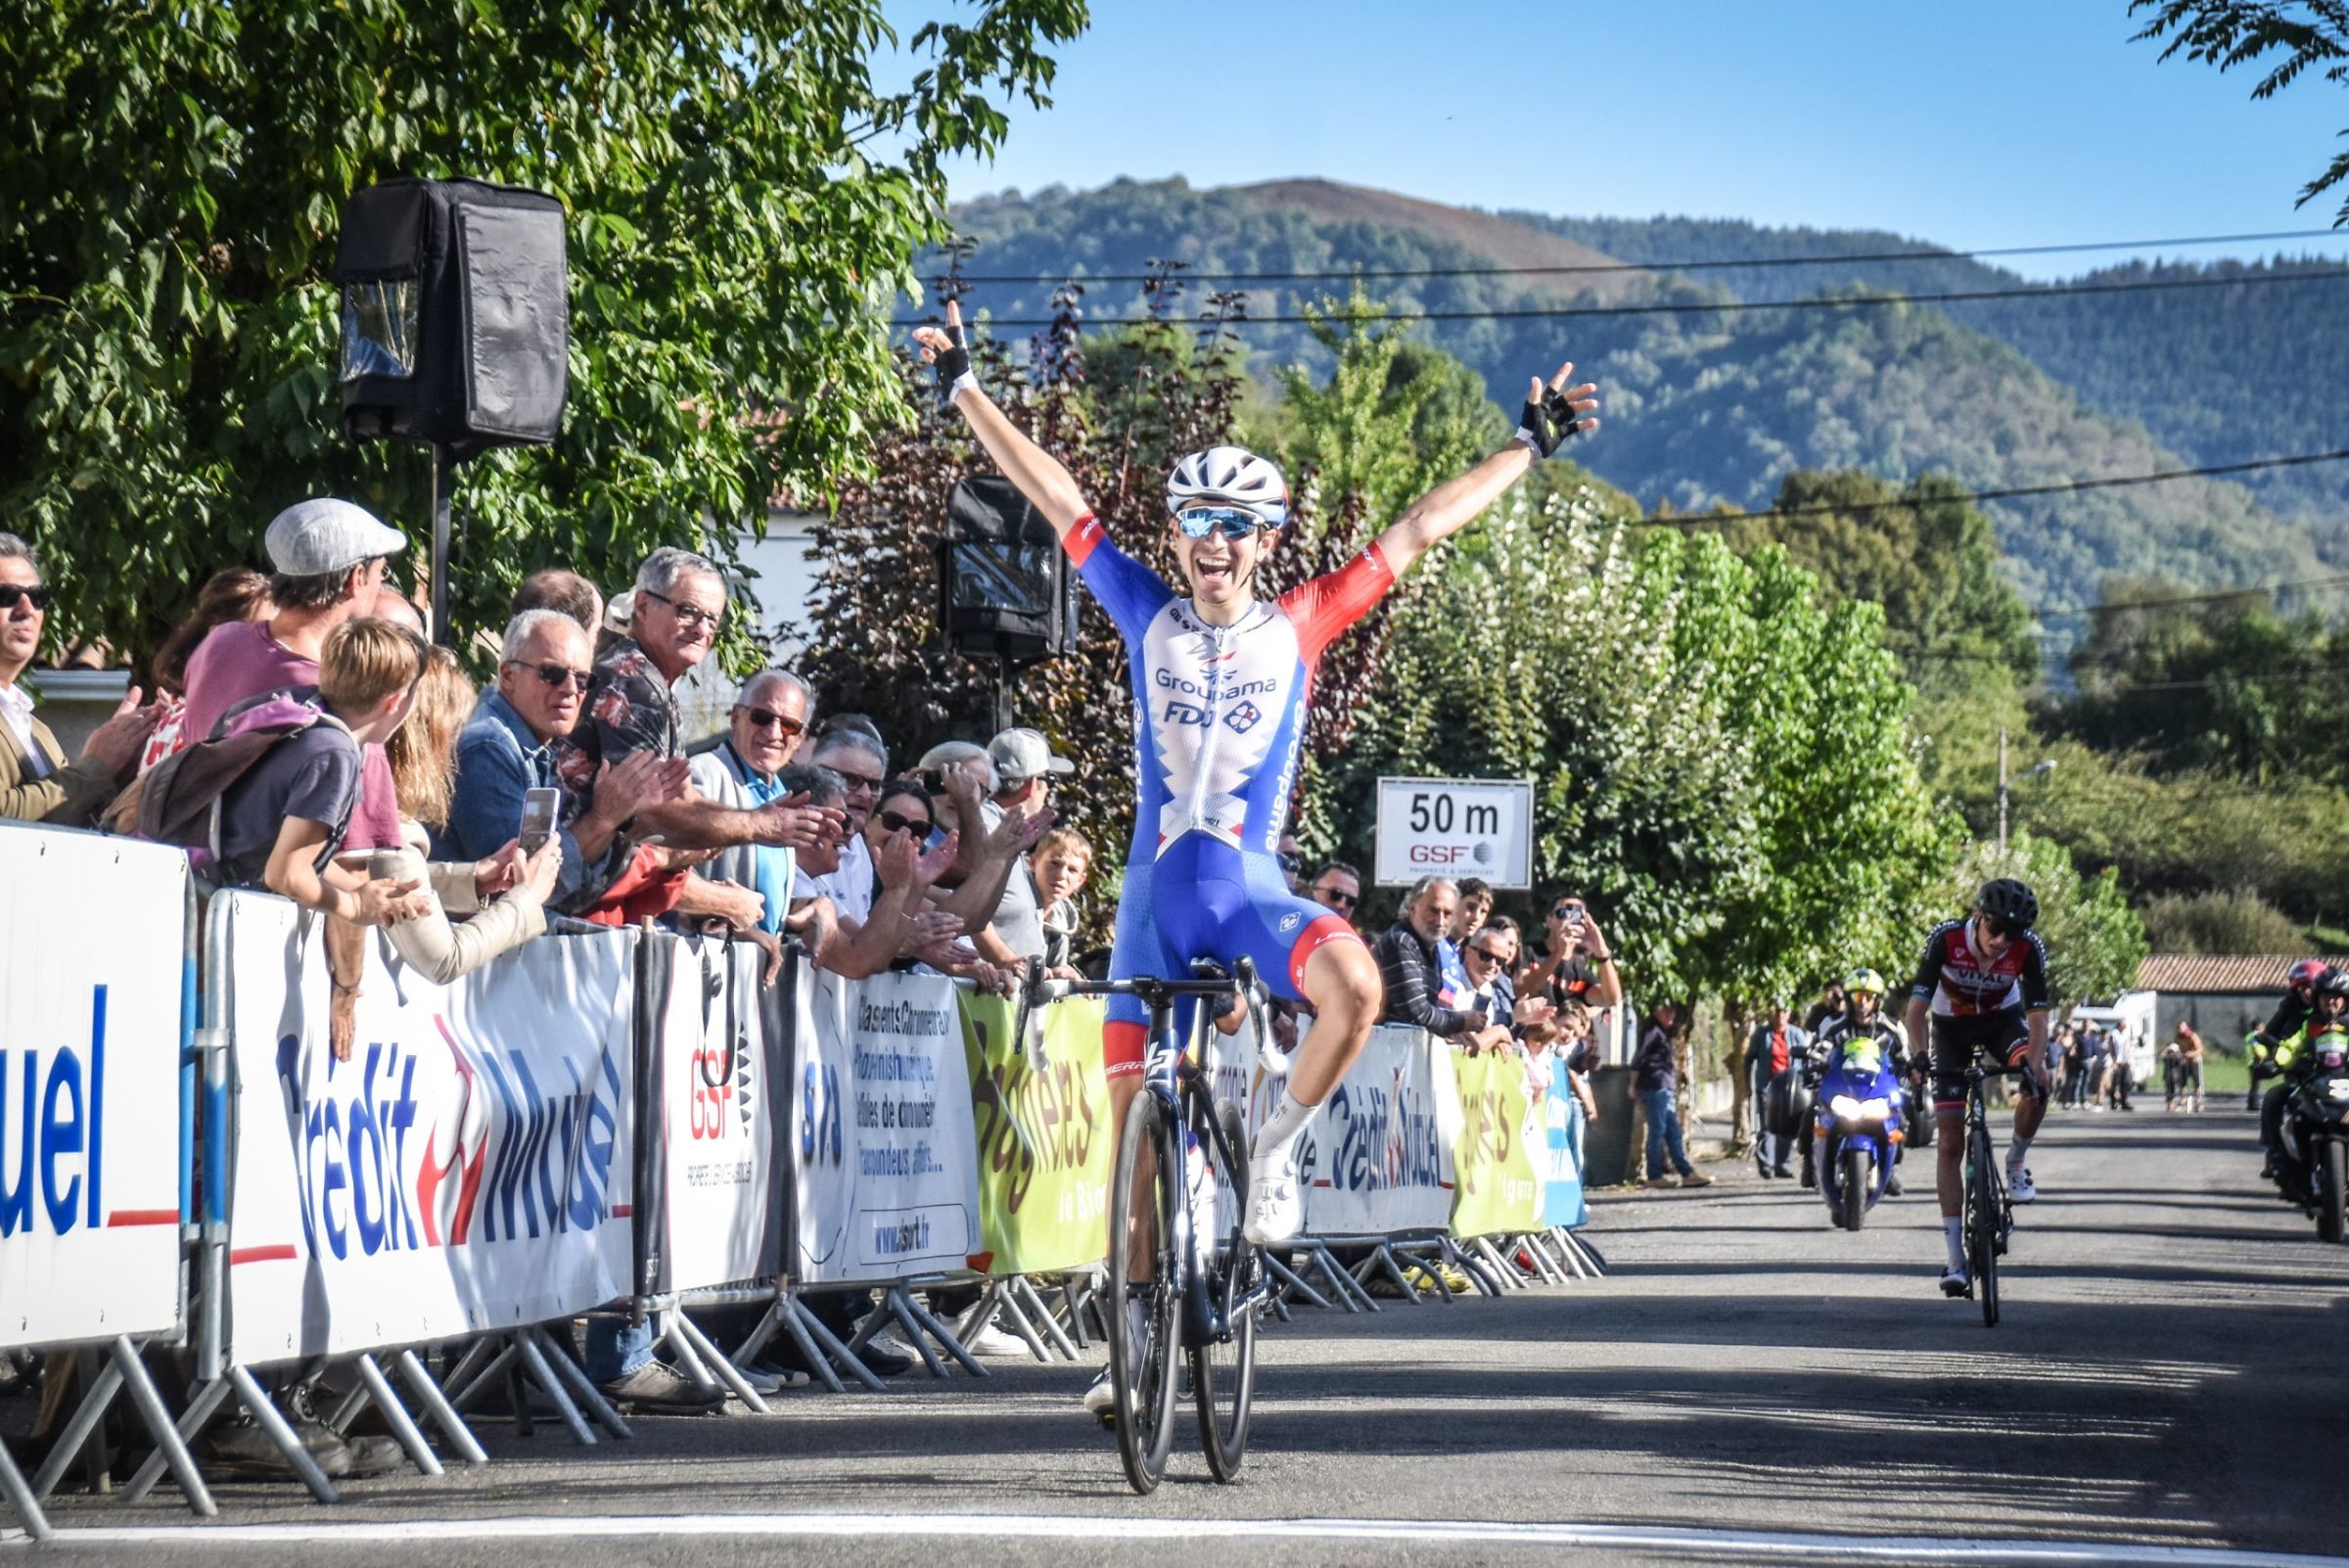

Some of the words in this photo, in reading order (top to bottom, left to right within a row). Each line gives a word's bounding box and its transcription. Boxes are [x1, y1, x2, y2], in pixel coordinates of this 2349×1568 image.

[1156, 668, 1276, 702] Groupama
[1164, 700, 1217, 728] FDJ
[1409, 793, 1453, 833] 50
[1465, 805, 1498, 835] m
[1409, 845, 1469, 863] GSF
